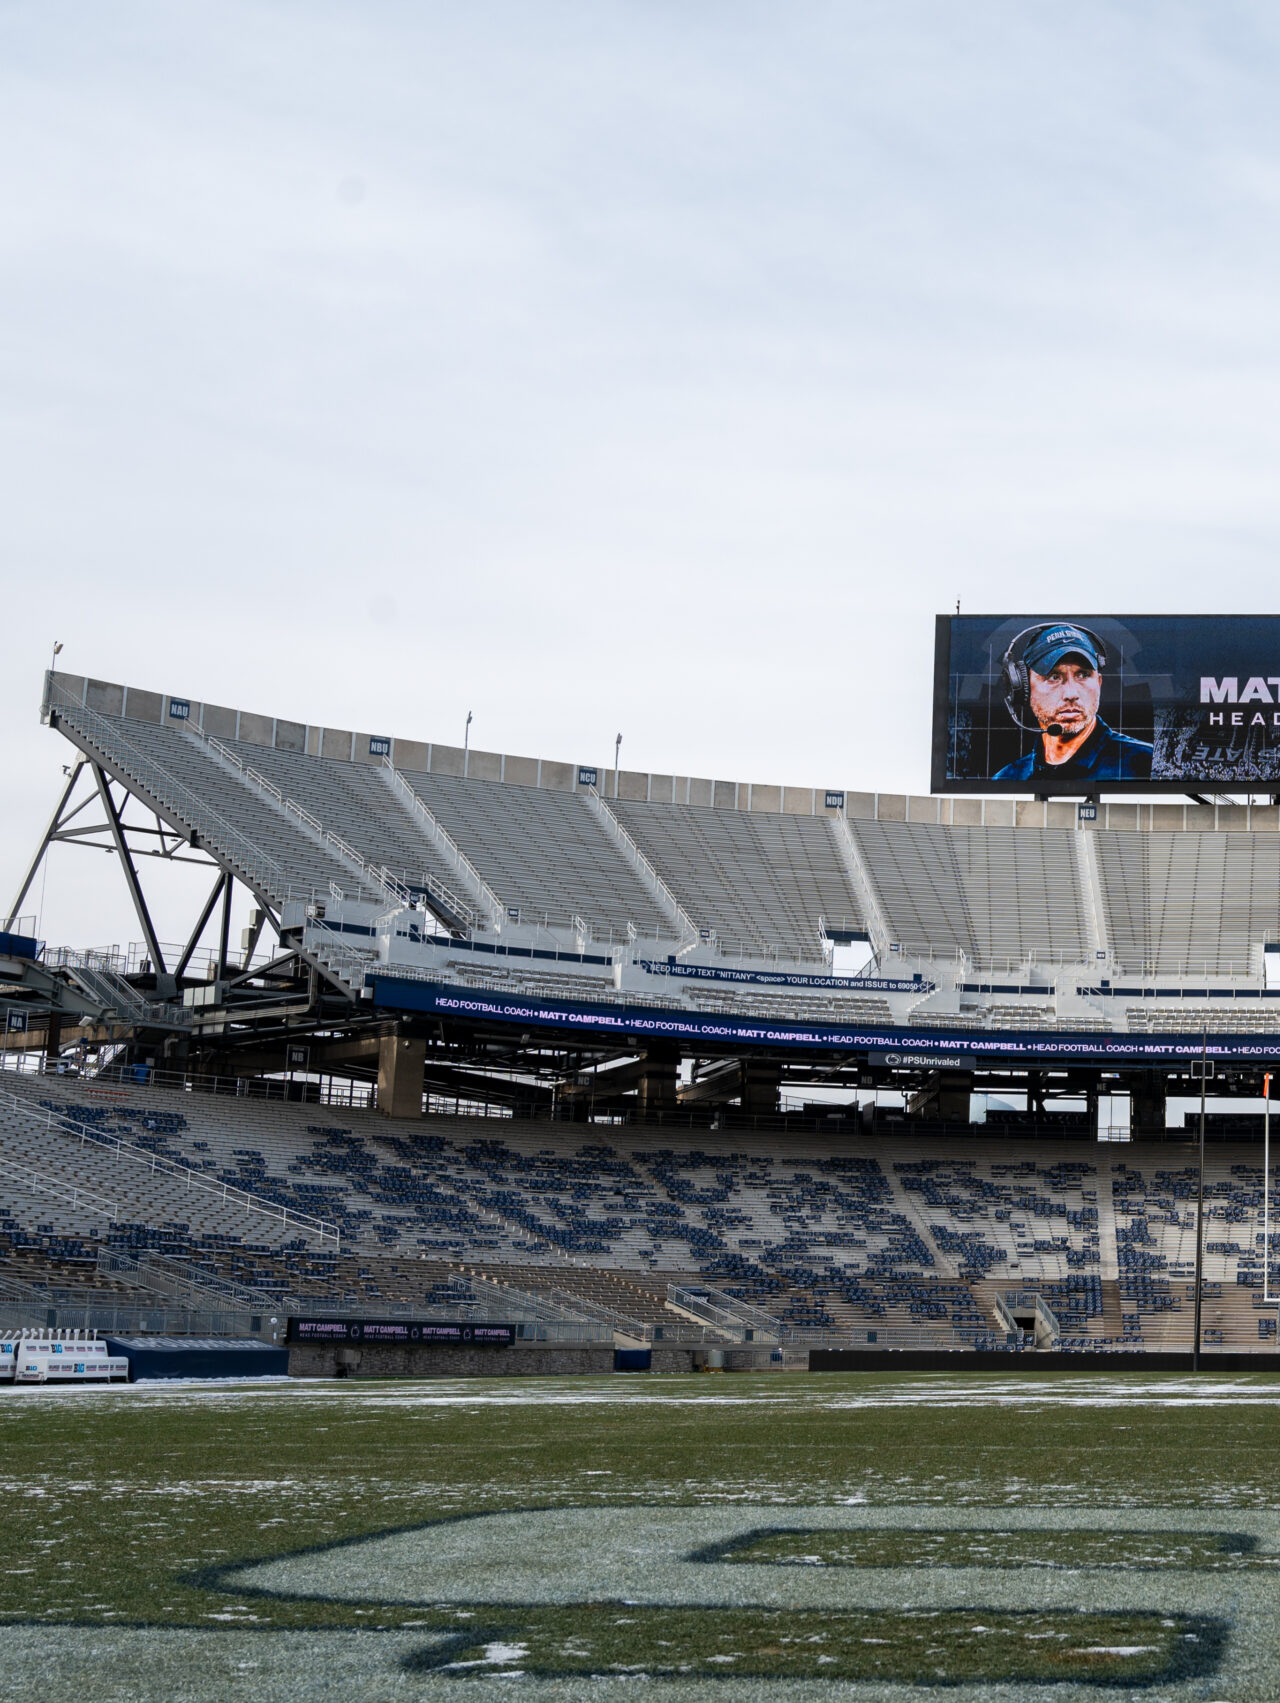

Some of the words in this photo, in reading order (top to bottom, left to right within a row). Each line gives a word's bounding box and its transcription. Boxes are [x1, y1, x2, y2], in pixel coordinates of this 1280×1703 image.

[171, 706, 188, 717] NAU
[371, 741, 388, 754] NBU
[580, 772, 596, 783] NCU
[827, 796, 842, 806] NDU
[1080, 810, 1094, 818] NEU
[672, 965, 696, 976] HELP?
[698, 968, 716, 978] TEXT
[756, 974, 785, 984] <space>
[787, 975, 808, 986] YOUR
[809, 977, 848, 988] LOCATION
[850, 979, 864, 988] and
[865, 979, 888, 990] ISSUE
[890, 982, 896, 990] to
[435, 998, 459, 1007] HEAD
[460, 1001, 503, 1013] FOOTBALL
[504, 1007, 533, 1016] COACH
[539, 1011, 567, 1020] MATT
[568, 1014, 624, 1025] CAMPBELL
[631, 1020, 654, 1028] HEAD
[656, 1022, 700, 1032] FOOTBALL
[702, 1026, 732, 1035] COACH
[737, 1029, 766, 1037] MATT
[767, 1032, 822, 1041] CAMPBELL
[854, 1037, 900, 1045] FOOTBALL
[971, 1042, 1026, 1050] CAMPBELL
[902, 1056, 960, 1067] #PSUnrivaled
[299, 1324, 316, 1332] MATT
[316, 1324, 348, 1332] CAMPBELL
